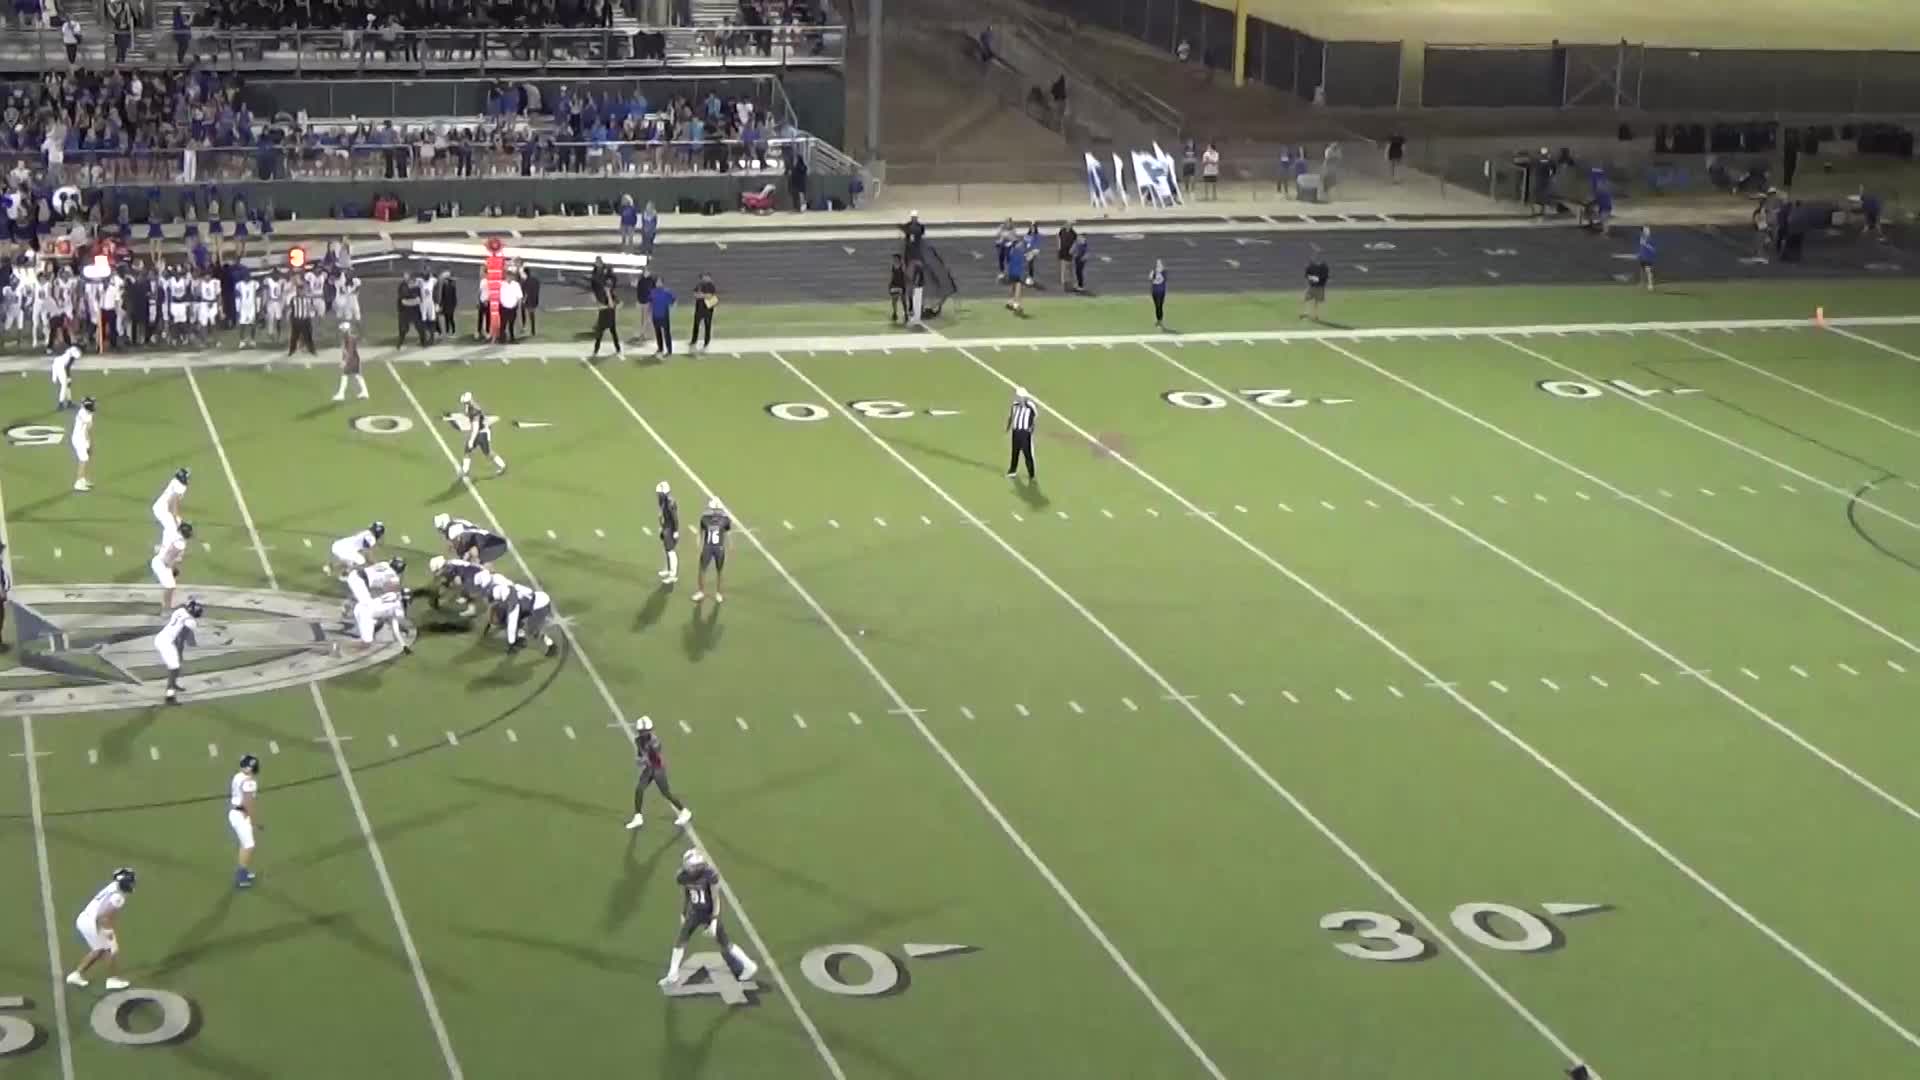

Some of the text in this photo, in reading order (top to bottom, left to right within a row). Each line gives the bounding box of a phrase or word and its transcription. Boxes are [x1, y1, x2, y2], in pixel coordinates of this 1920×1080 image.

[1167, 389, 1308, 408] 20
[1541, 379, 1662, 398] 10
[770, 401, 914, 421] 30
[1320, 902, 1552, 960] 30
[662, 944, 898, 1004] 40
